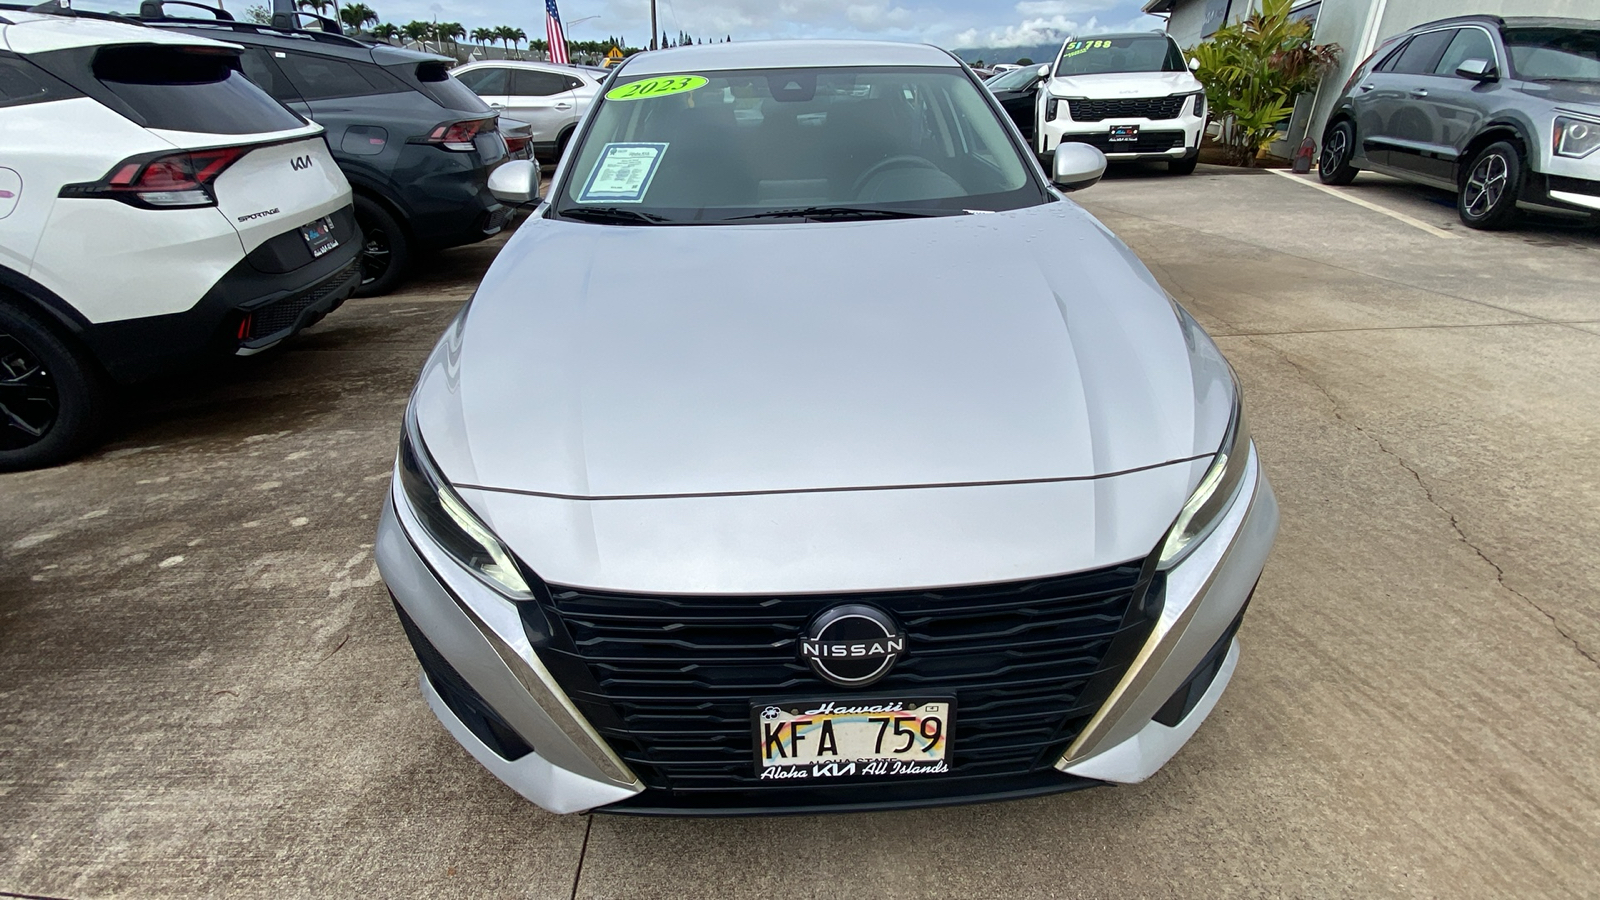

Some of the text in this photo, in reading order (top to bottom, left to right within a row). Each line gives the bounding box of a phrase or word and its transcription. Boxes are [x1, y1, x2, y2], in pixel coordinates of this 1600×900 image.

[620, 77, 692, 98] 2023
[290, 155, 313, 171] KIA
[238, 207, 280, 222] SPORTAGE
[803, 638, 903, 657] NISSAN
[804, 702, 903, 715] Hawaii
[764, 716, 942, 760] KFA 759
[760, 760, 949, 780] Aloha KIA All Islands
